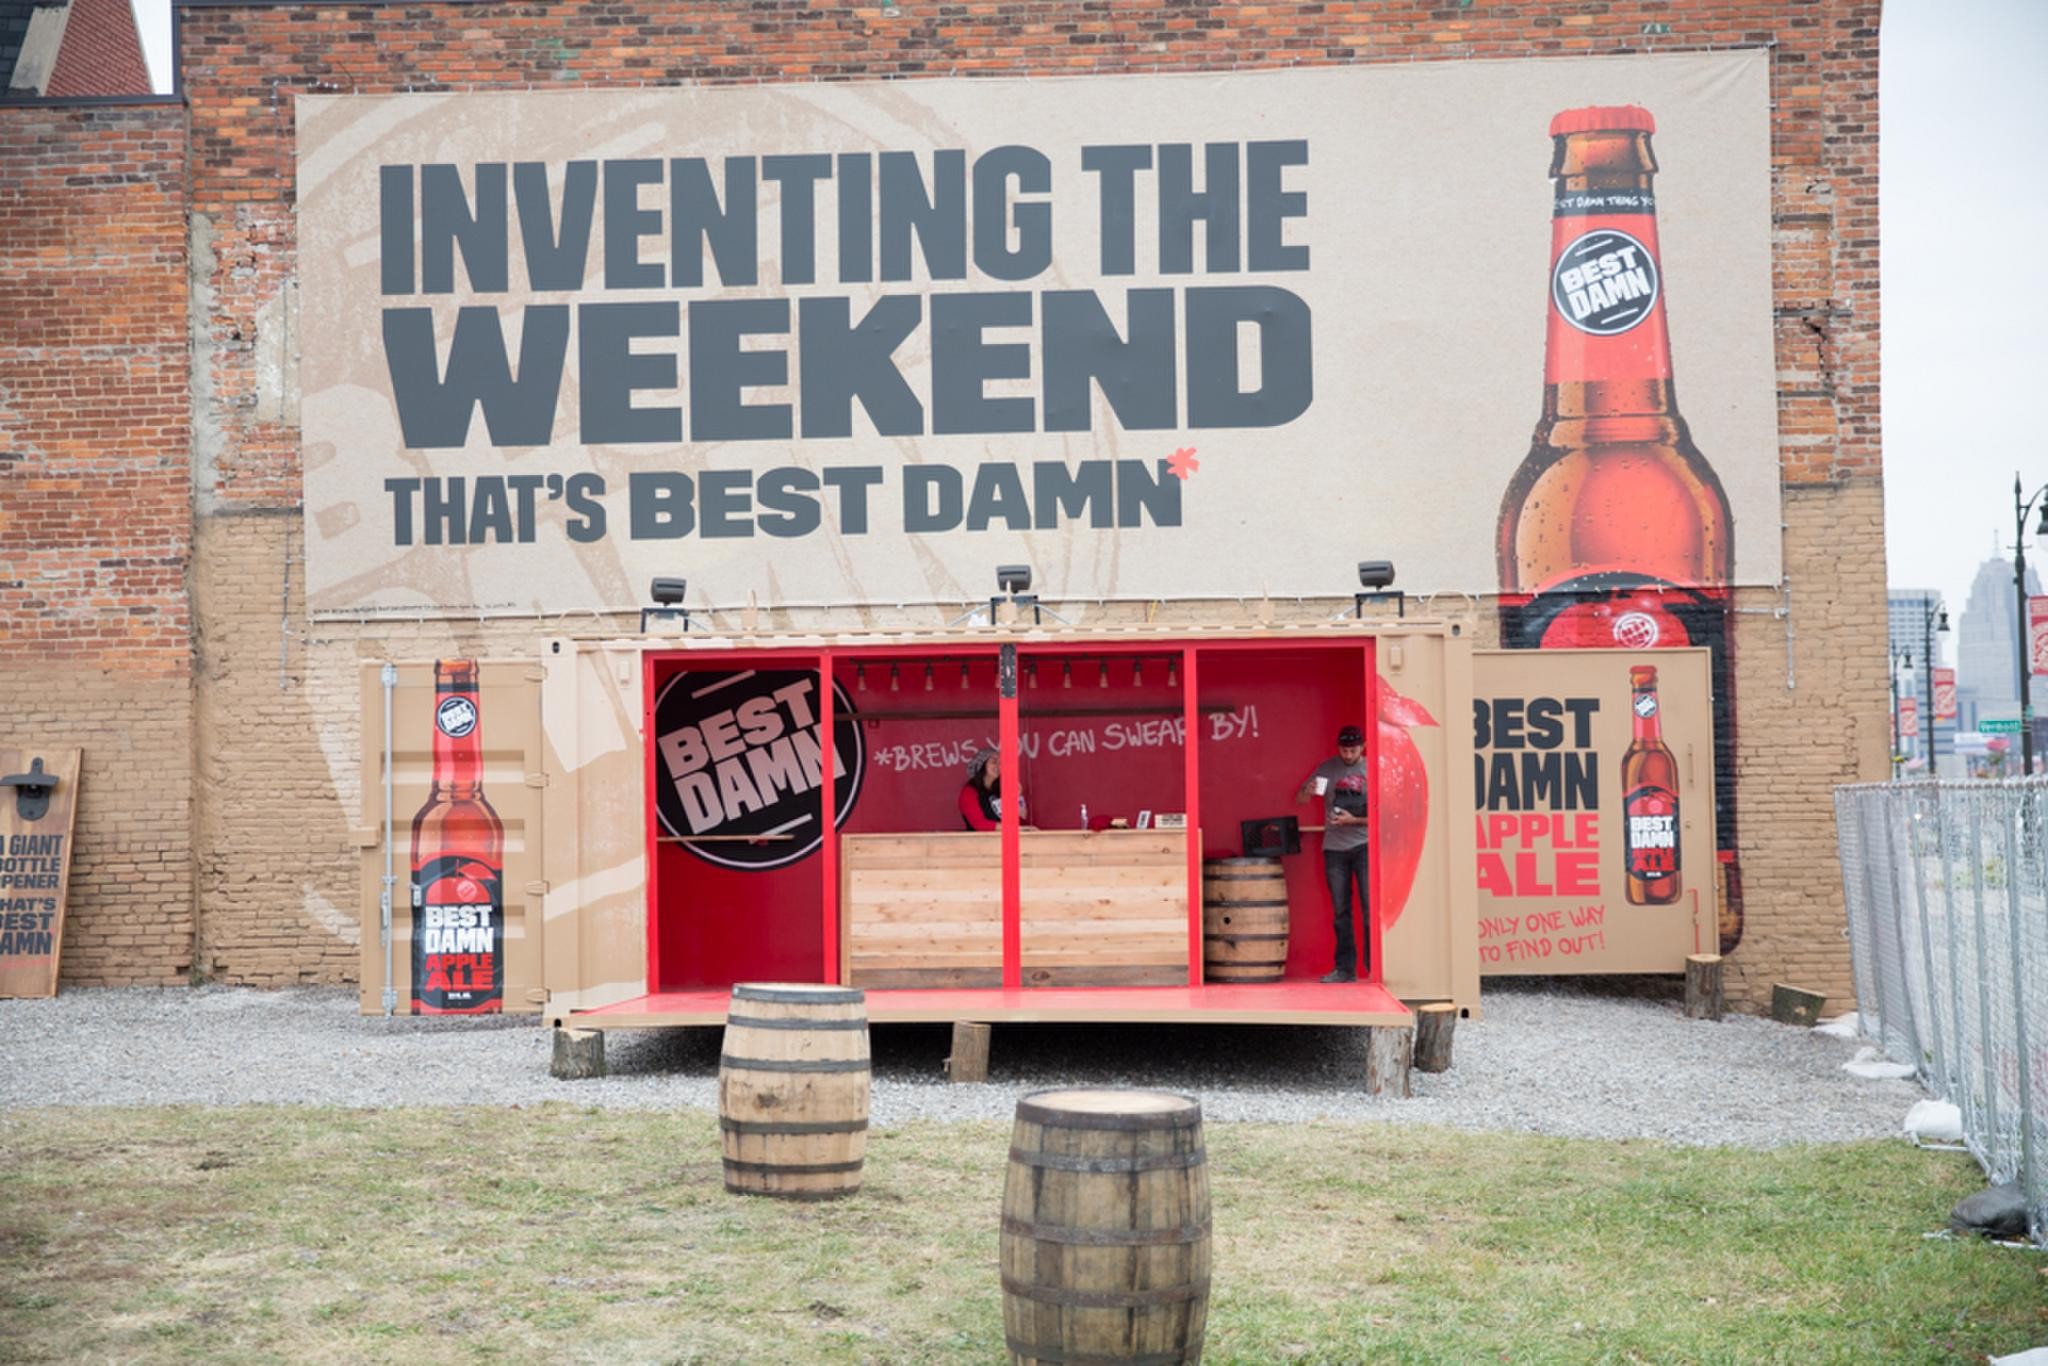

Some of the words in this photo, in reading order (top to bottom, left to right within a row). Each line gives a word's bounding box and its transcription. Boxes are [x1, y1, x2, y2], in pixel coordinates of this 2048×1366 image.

[380, 145, 1053, 295] INVENTING
[1081, 140, 1310, 276] THE
[1560, 245, 1637, 294] BEST
[1567, 266, 1652, 321] DAMN
[382, 285, 1314, 449] WEEKEND
[384, 473, 607, 546] THAT'S
[629, 466, 884, 541] BEST
[657, 677, 815, 779] BEST
[1048, 729, 1096, 757] CAN
[1208, 705, 1259, 741] BY!
[674, 722, 847, 835] DAMN
[1630, 816, 1673, 831] BEST
[9, 834, 64, 856] GIANT
[0, 857, 61, 873] OTTLE
[1477, 852, 1601, 896] ALE
[1, 874, 60, 889] PENER
[0, 896, 56, 911] HAT'S
[425, 905, 493, 928] BEST
[1525, 910, 1566, 934] ONE
[1569, 904, 1605, 928] WAY
[0, 932, 52, 955] AMN
[425, 928, 494, 953] DAMN
[1478, 945, 1501, 962] TO
[1506, 937, 1553, 961] FIND
[1558, 930, 1606, 955] OUT!
[425, 954, 494, 971] APPLE
[425, 971, 494, 992] ALE
